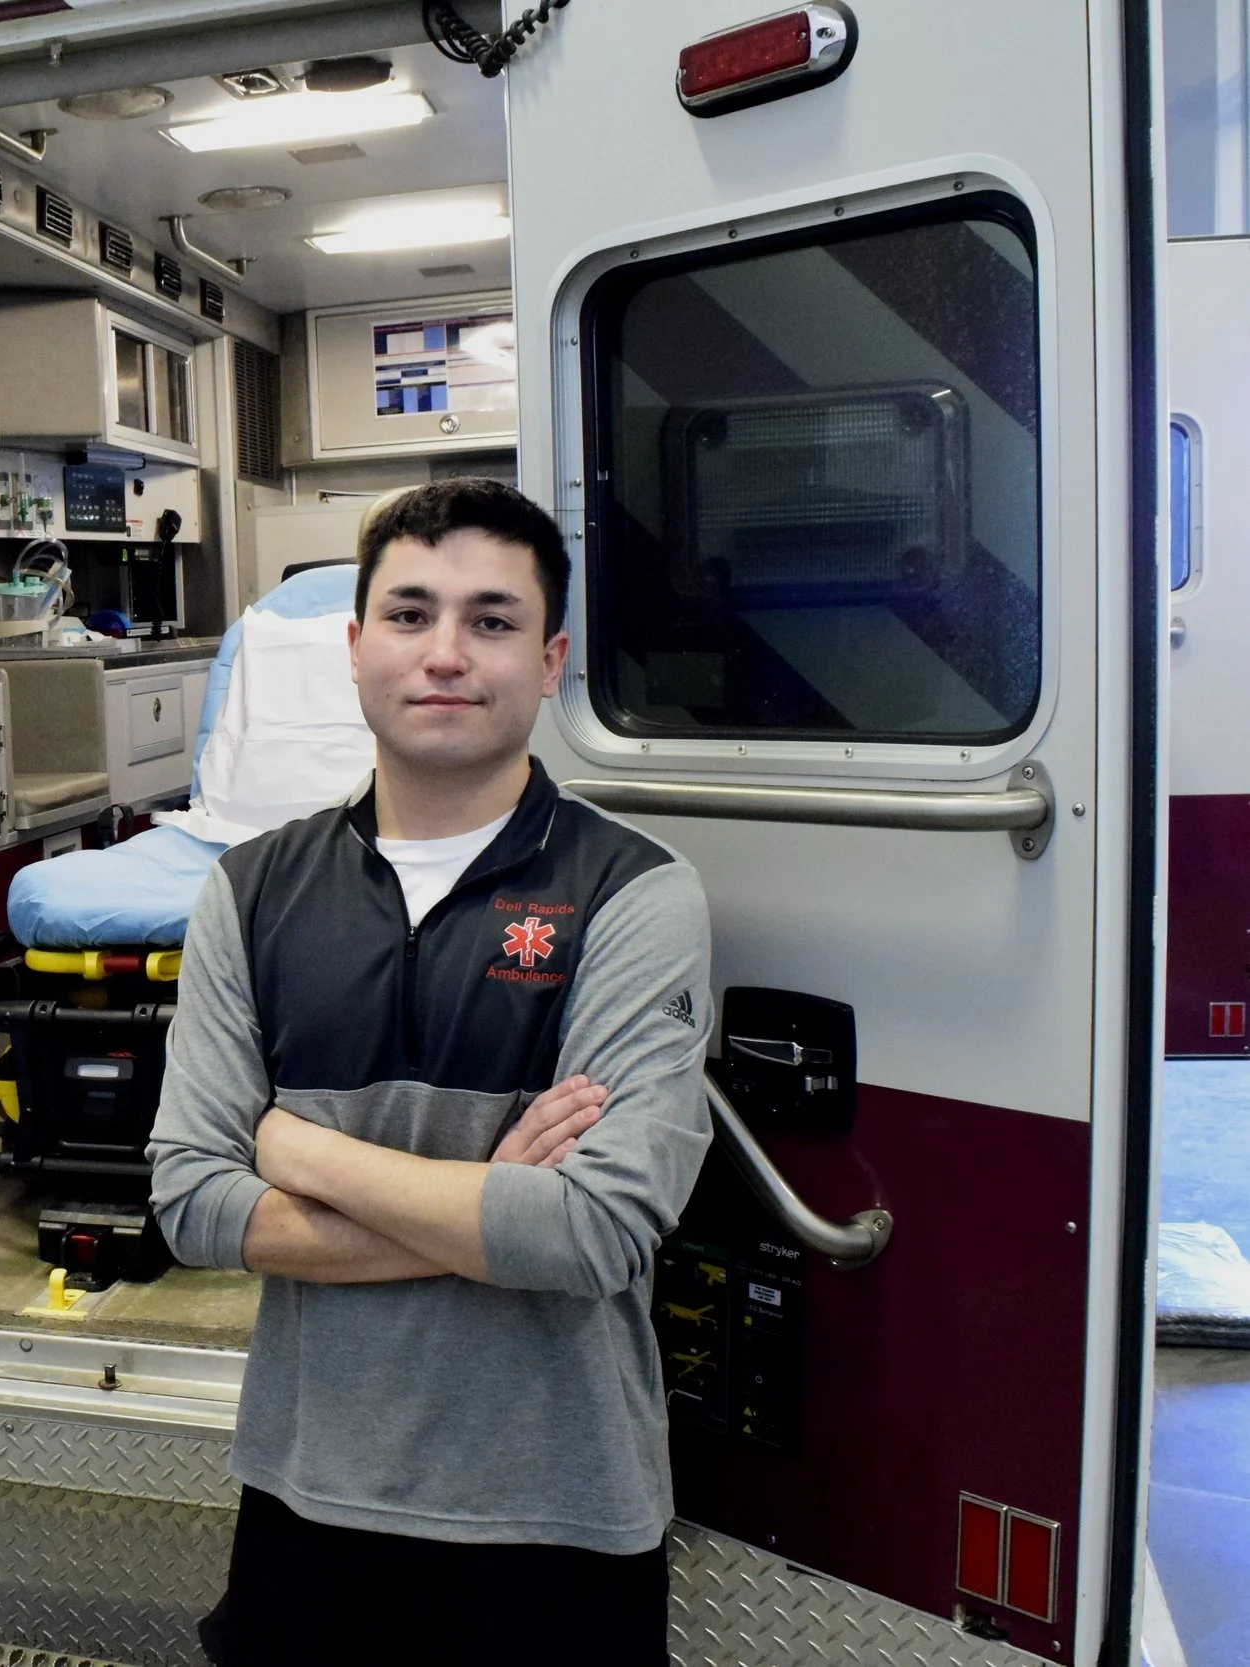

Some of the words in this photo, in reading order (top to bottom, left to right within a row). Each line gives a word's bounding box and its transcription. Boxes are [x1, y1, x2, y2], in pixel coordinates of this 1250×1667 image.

[494, 898, 522, 912] Dell
[527, 903, 575, 915] Rapids
[485, 965, 567, 984] Ambulance
[661, 1005, 696, 1029] adidas
[759, 1241, 801, 1260] stryker
